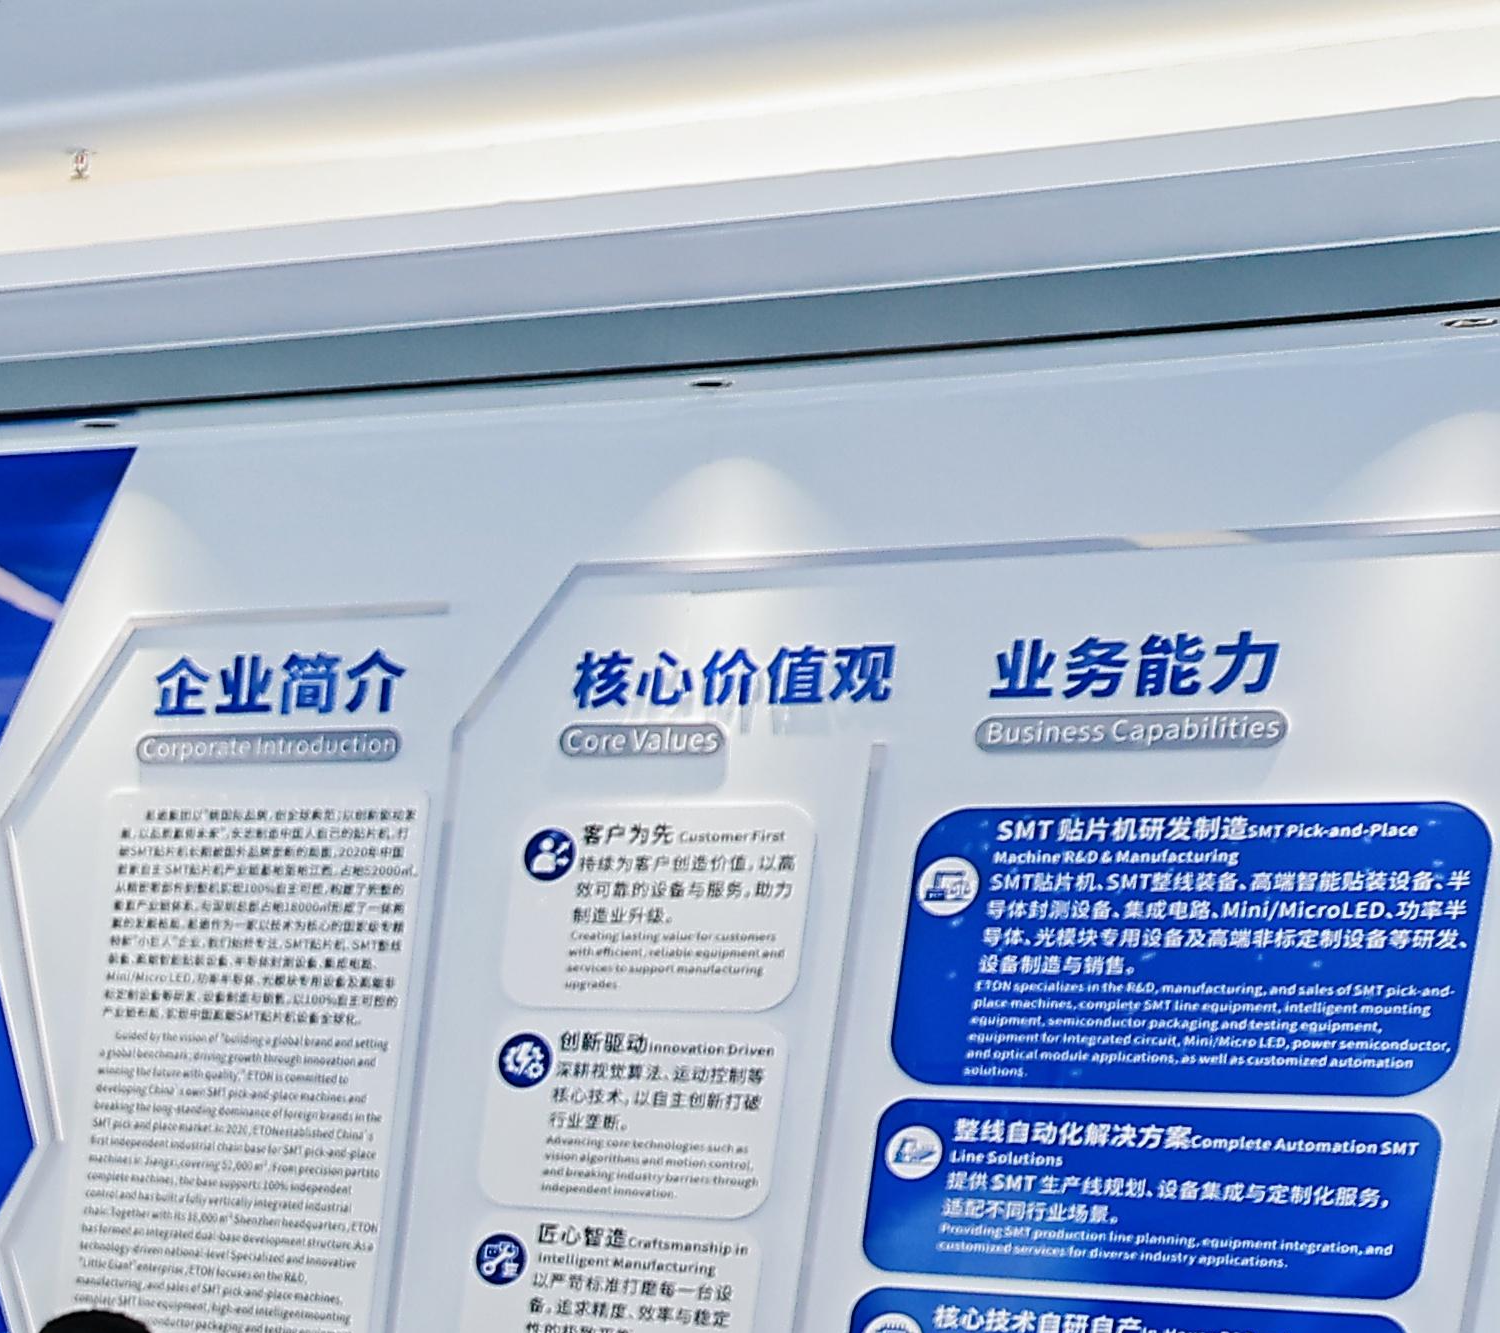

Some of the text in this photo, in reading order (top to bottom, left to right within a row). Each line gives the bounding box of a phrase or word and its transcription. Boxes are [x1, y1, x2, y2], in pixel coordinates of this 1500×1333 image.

[573, 643, 896, 707] 核心价值观
[988, 630, 1281, 700] 业务能力
[153, 648, 407, 717] 企业简介
[567, 727, 718, 753] Core Values
[986, 716, 1281, 745] Business Capabilities
[141, 730, 396, 762] Corporate Introduction
[583, 823, 674, 845] 客户为先
[679, 829, 786, 843] Customer First
[996, 819, 1054, 842] SMT
[1286, 823, 1419, 840] Pick-and-Place
[992, 850, 1060, 865] Machine
[1061, 850, 1098, 865] R&D
[1115, 848, 1239, 866] Manufacturing
[1269, 984, 1296, 996] and
[1360, 1004, 1432, 1018] mounting
[561, 1031, 648, 1053] 创新驱动
[728, 1044, 775, 1057] Driven
[952, 1117, 1419, 1156] 整线自动化解决方案 Complete Automation SMT
[950, 1150, 1063, 1167] Line Solutions
[537, 1222, 627, 1248] 匠心智造
[628, 1236, 732, 1256] Craftsmanship
[1366, 1244, 1393, 1256] and
[613, 1257, 716, 1277] Manufacturing
